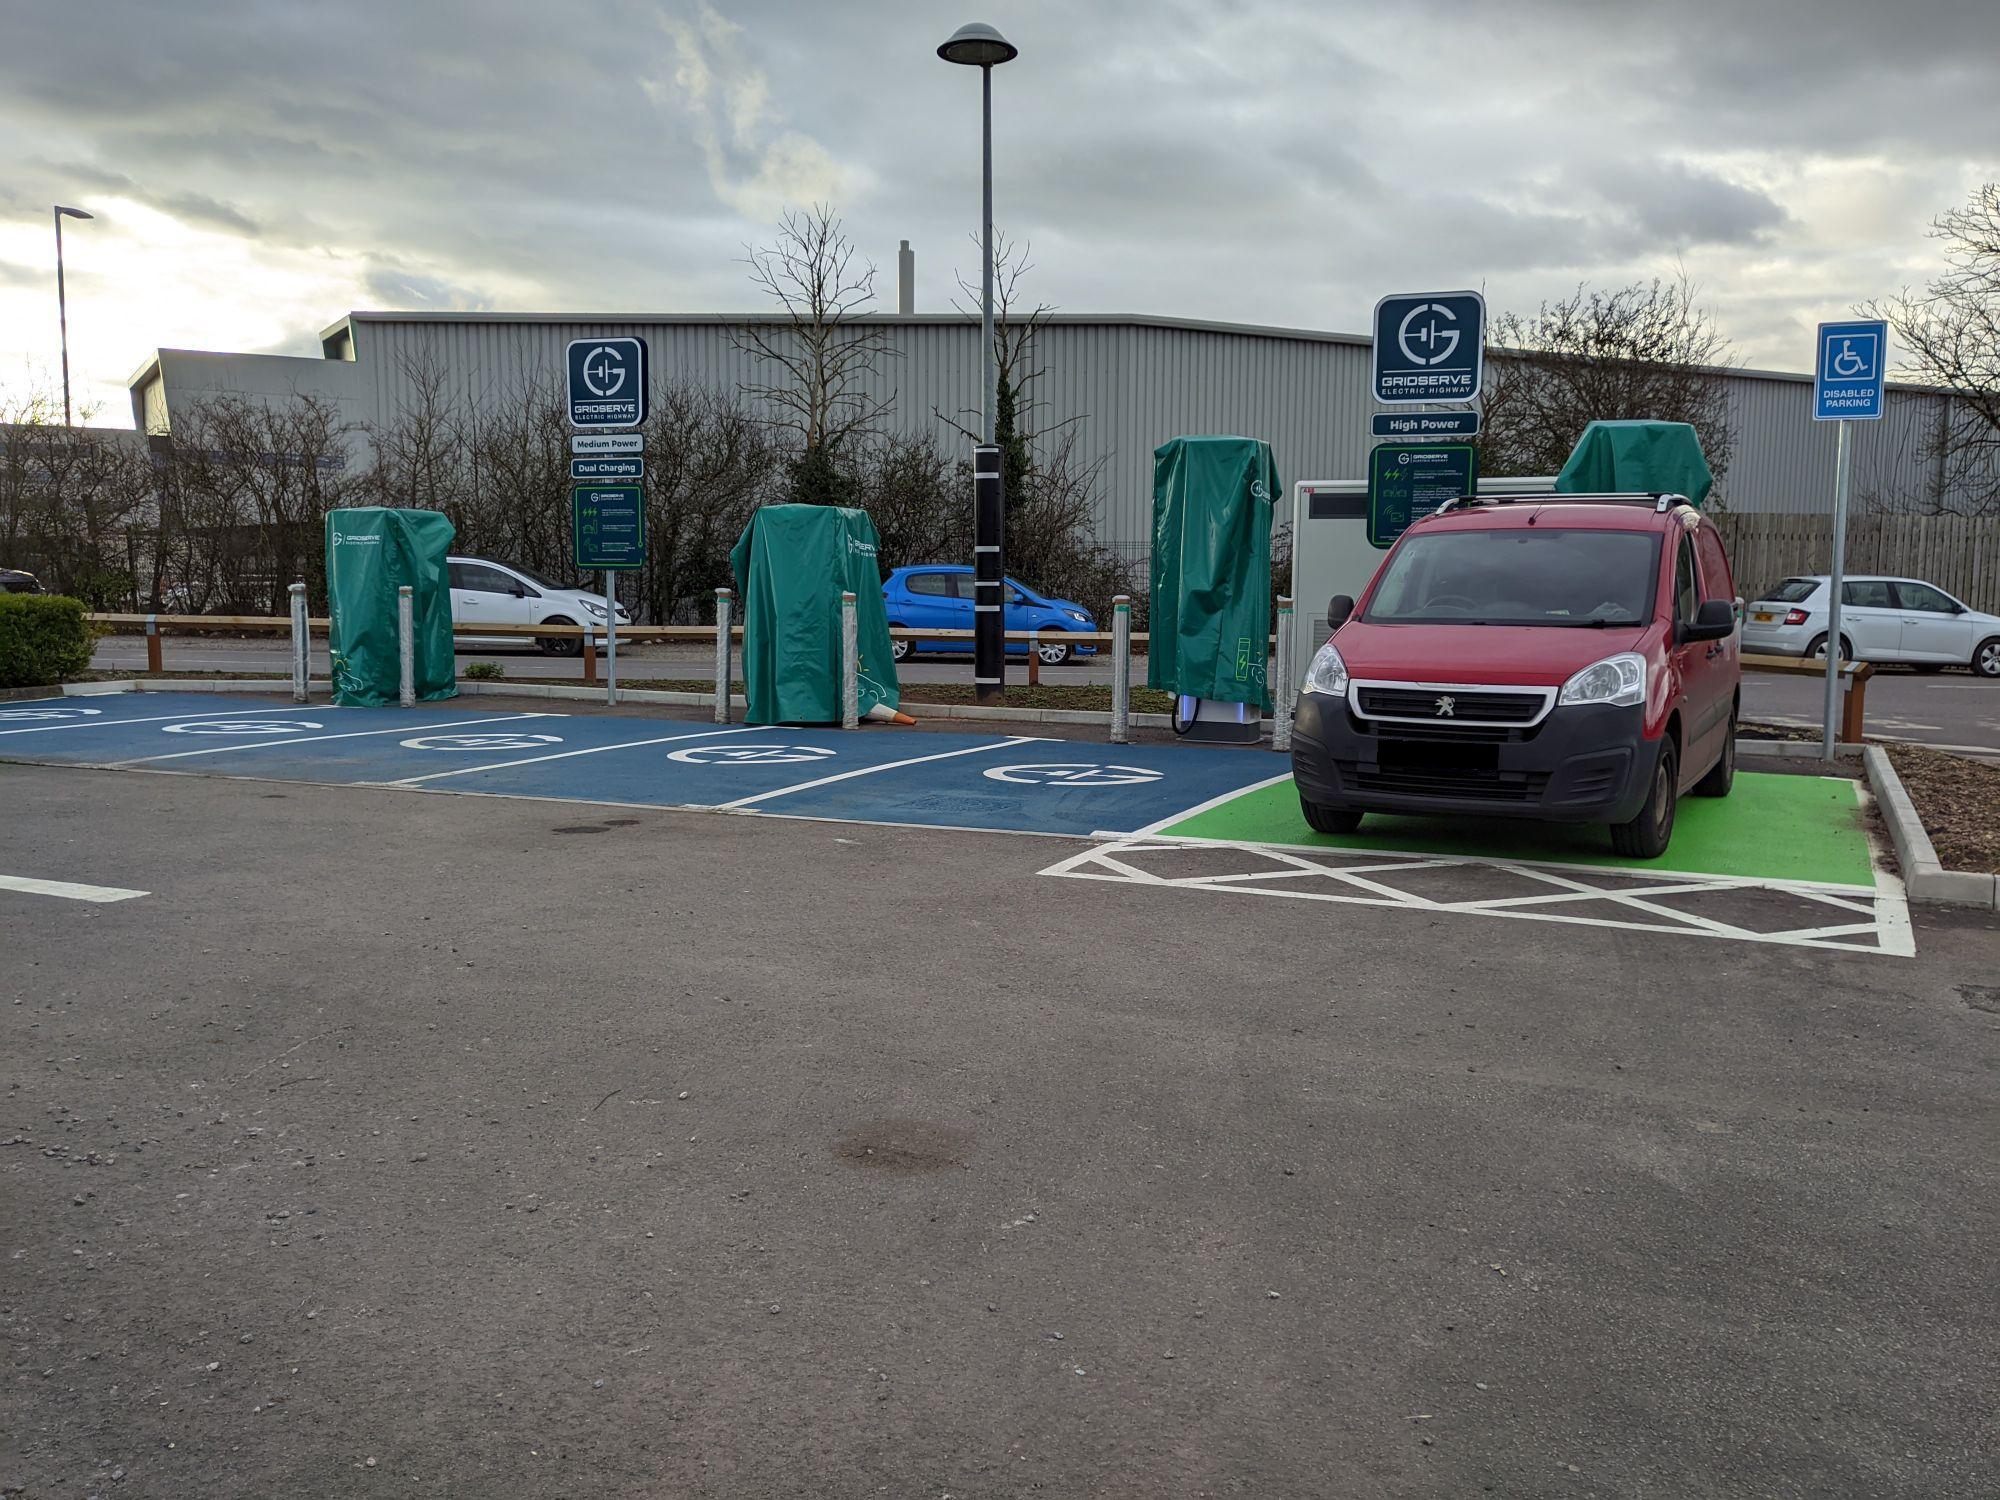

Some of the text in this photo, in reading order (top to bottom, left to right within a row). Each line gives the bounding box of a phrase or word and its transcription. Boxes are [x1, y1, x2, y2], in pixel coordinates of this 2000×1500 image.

[1381, 375, 1471, 387] GRIDSERVE
[1429, 386, 1471, 394] HIGHWAY
[1823, 389, 1875, 398] DISABLED
[1826, 398, 1871, 408] PARKING
[574, 404, 636, 414] GRIDSERVE
[1390, 419, 1460, 431] High Power
[577, 439, 638, 448] Medium Power
[578, 462, 636, 473] Dual Charging
